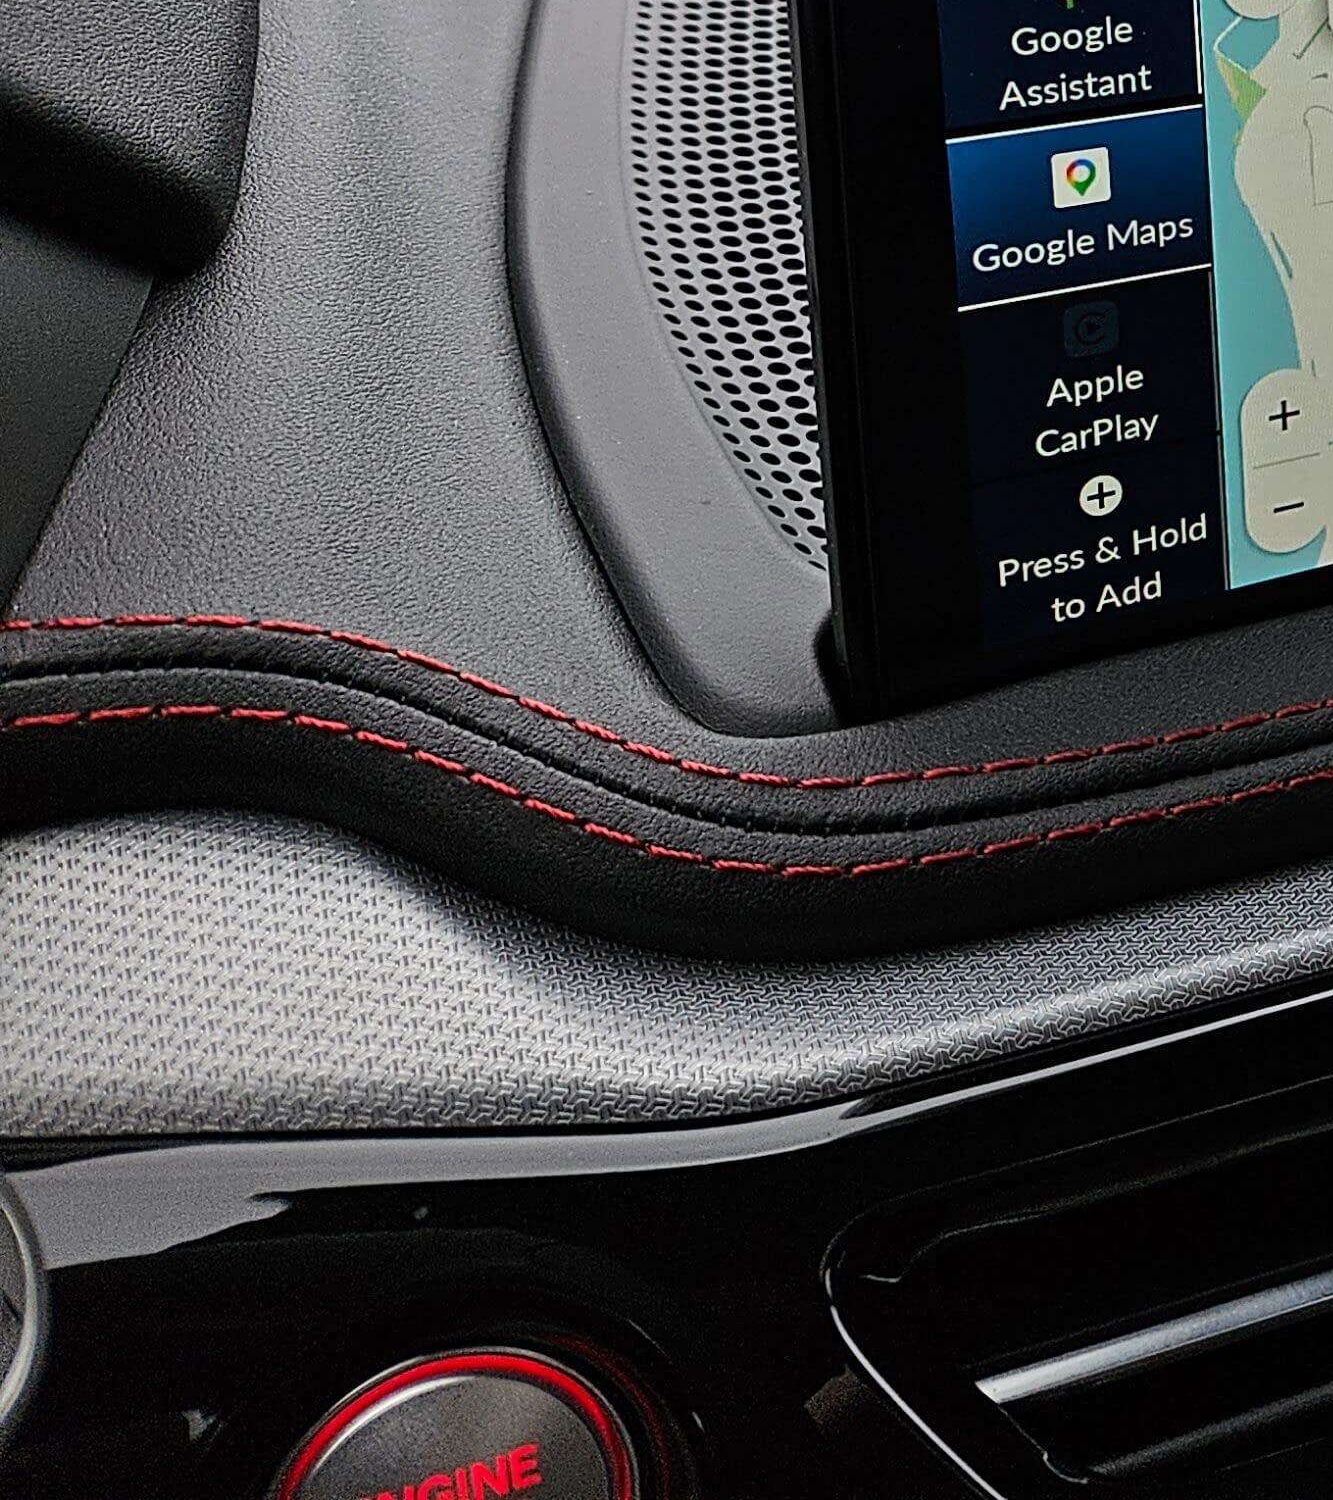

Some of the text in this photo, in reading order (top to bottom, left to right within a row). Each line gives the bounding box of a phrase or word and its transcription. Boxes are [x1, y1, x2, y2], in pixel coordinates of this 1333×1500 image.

[1011, 16, 1134, 58] Google
[999, 65, 1153, 111] Assistant
[972, 216, 1194, 273] Google Maps
[1046, 366, 1144, 407] Apple
[1035, 414, 1160, 457] CarPlay
[998, 513, 1207, 587] Press & Hold
[1051, 572, 1163, 622] to Add
[360, 1441, 543, 1500] GINE
